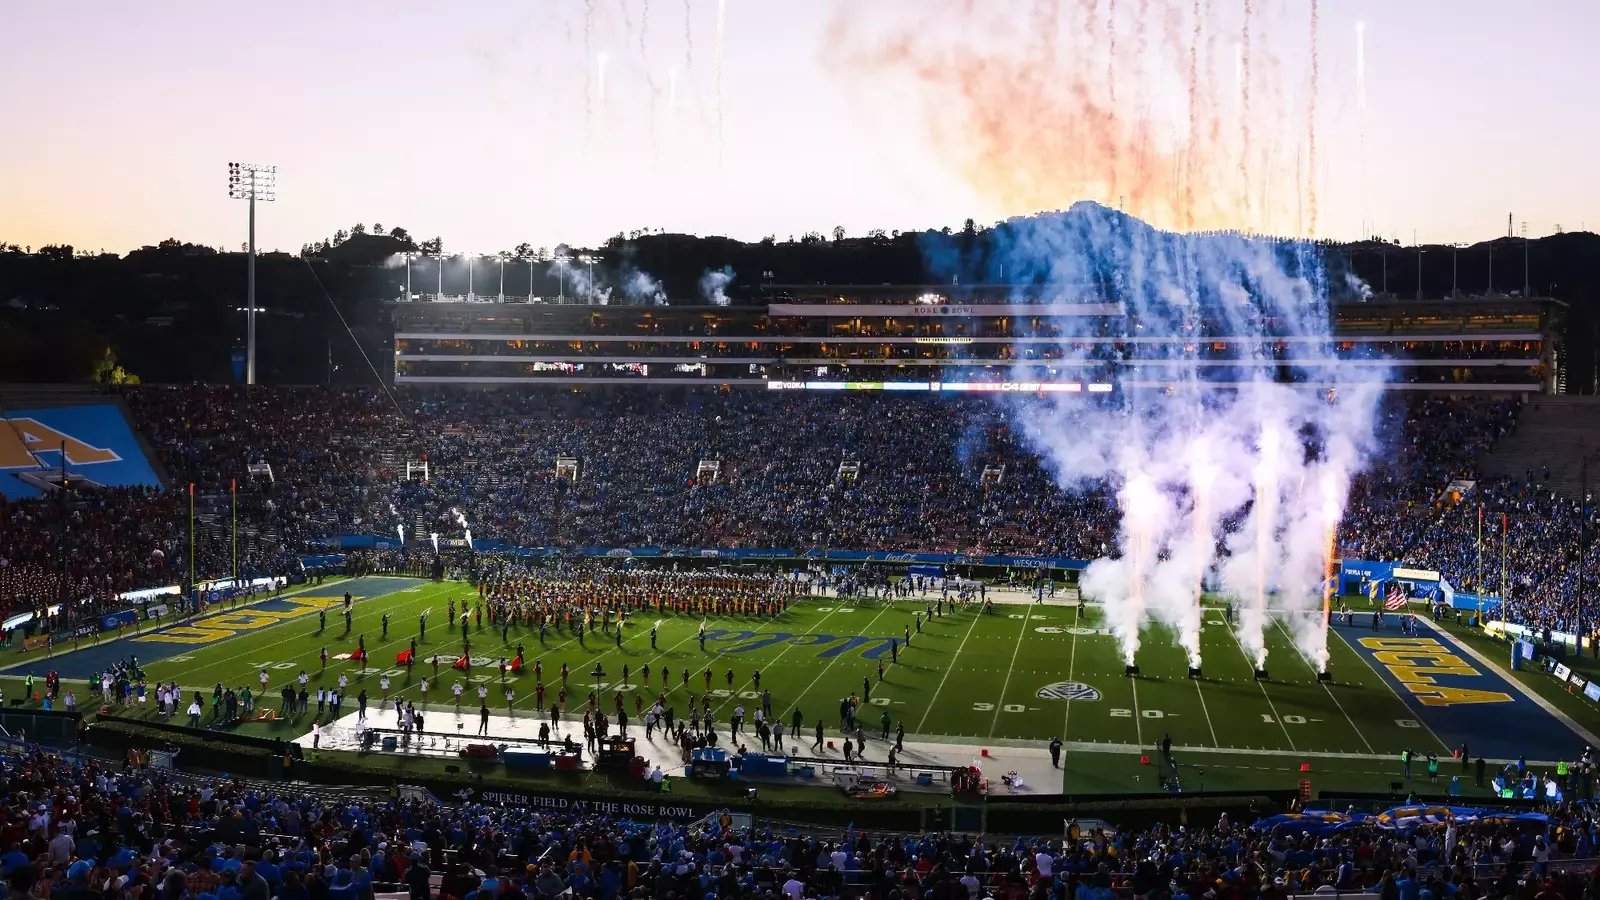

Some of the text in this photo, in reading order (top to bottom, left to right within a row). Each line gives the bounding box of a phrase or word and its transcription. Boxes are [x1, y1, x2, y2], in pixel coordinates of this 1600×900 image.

[782, 382, 806, 390] VODKA
[1013, 559, 1048, 568] WESCOM
[130, 596, 366, 643] UCLA
[1357, 637, 1515, 706] UCLA
[973, 702, 1026, 713] 30
[1109, 708, 1164, 719] 20
[1260, 713, 1307, 724] 10
[482, 791, 696, 818] SPIEKER FIELD AT THE ROSE BOWL
